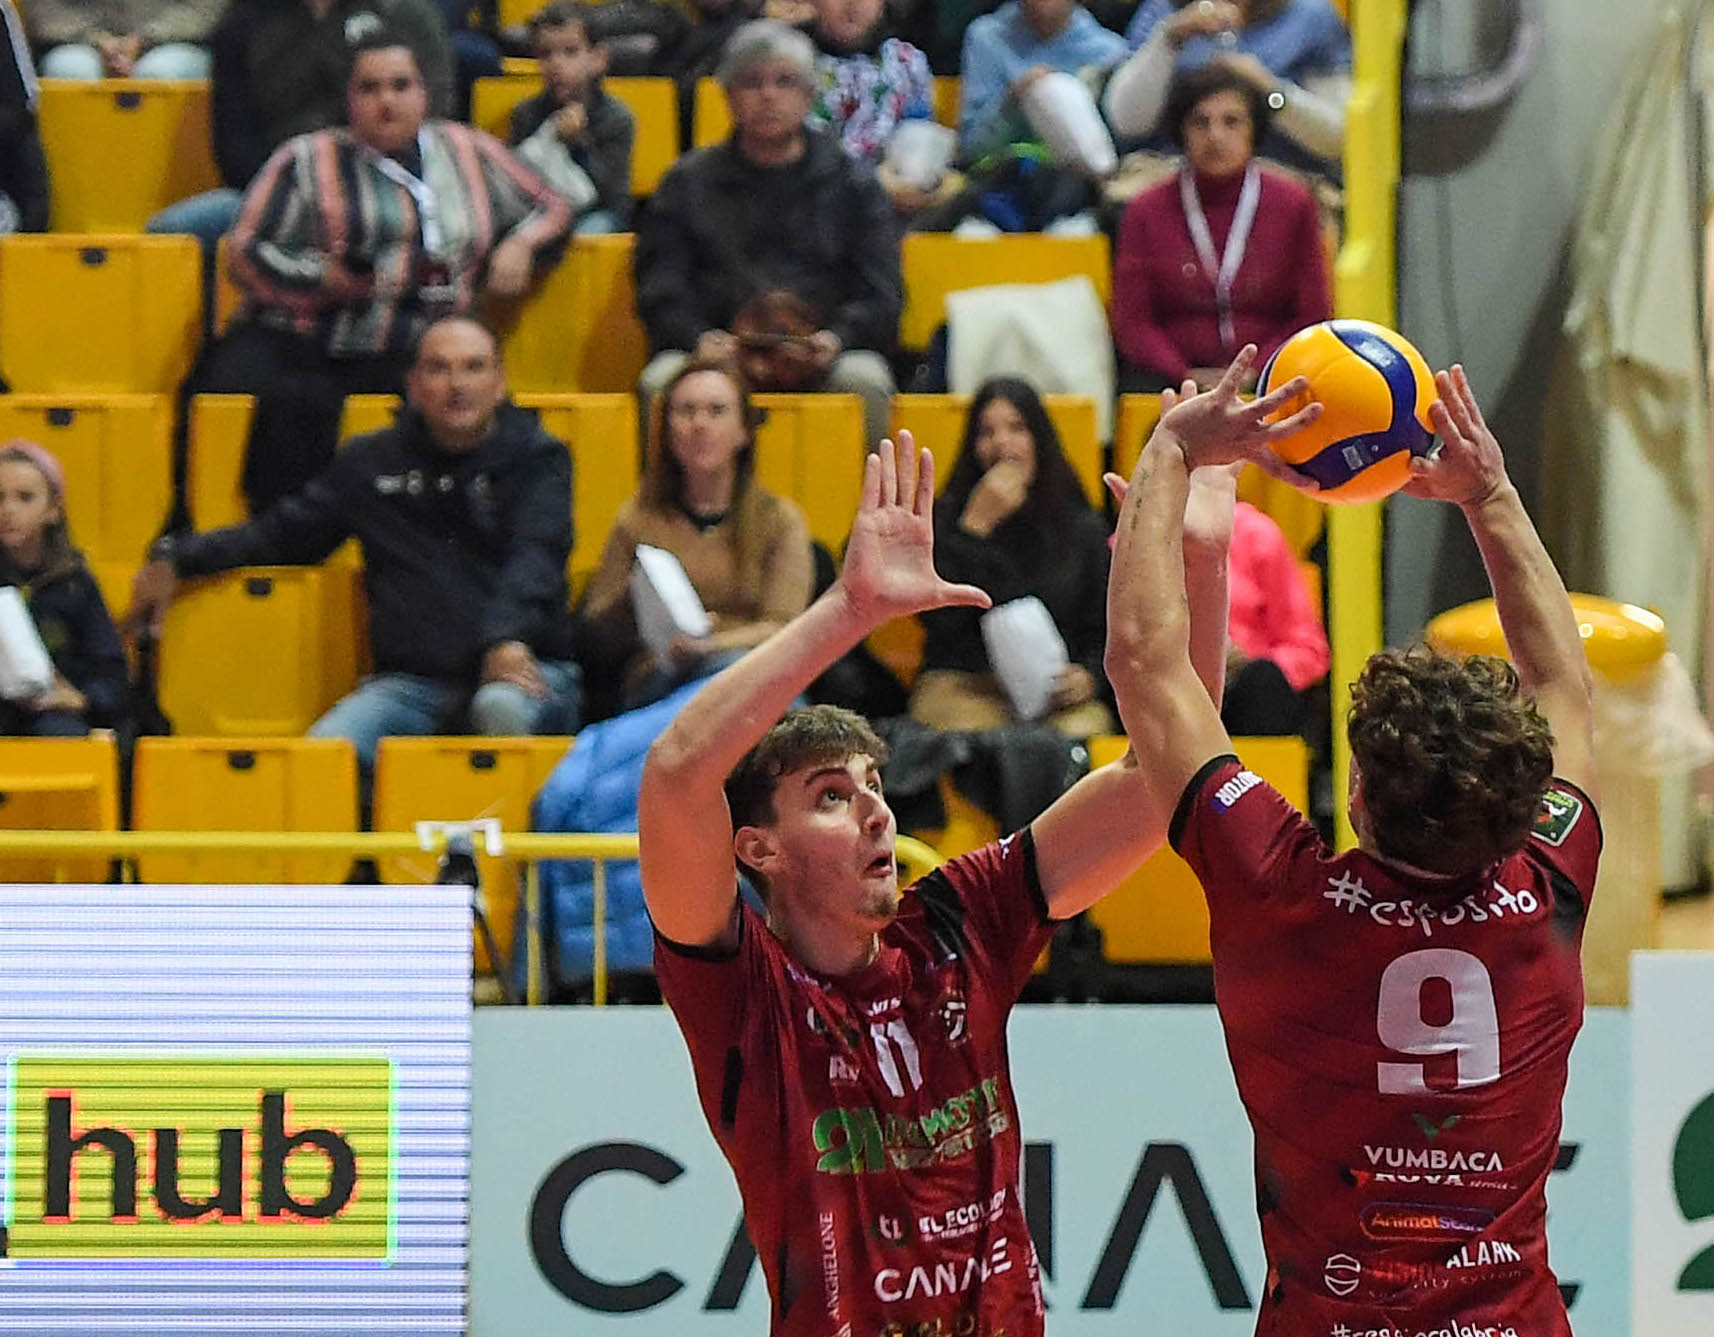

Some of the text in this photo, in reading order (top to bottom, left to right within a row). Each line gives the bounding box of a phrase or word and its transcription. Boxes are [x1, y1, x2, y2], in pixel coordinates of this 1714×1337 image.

[870, 1018, 923, 1098] 11
[1376, 947, 1502, 1096] 9
[43, 1090, 357, 1225] hub
[1364, 1145, 1503, 1172] VUMBACA
